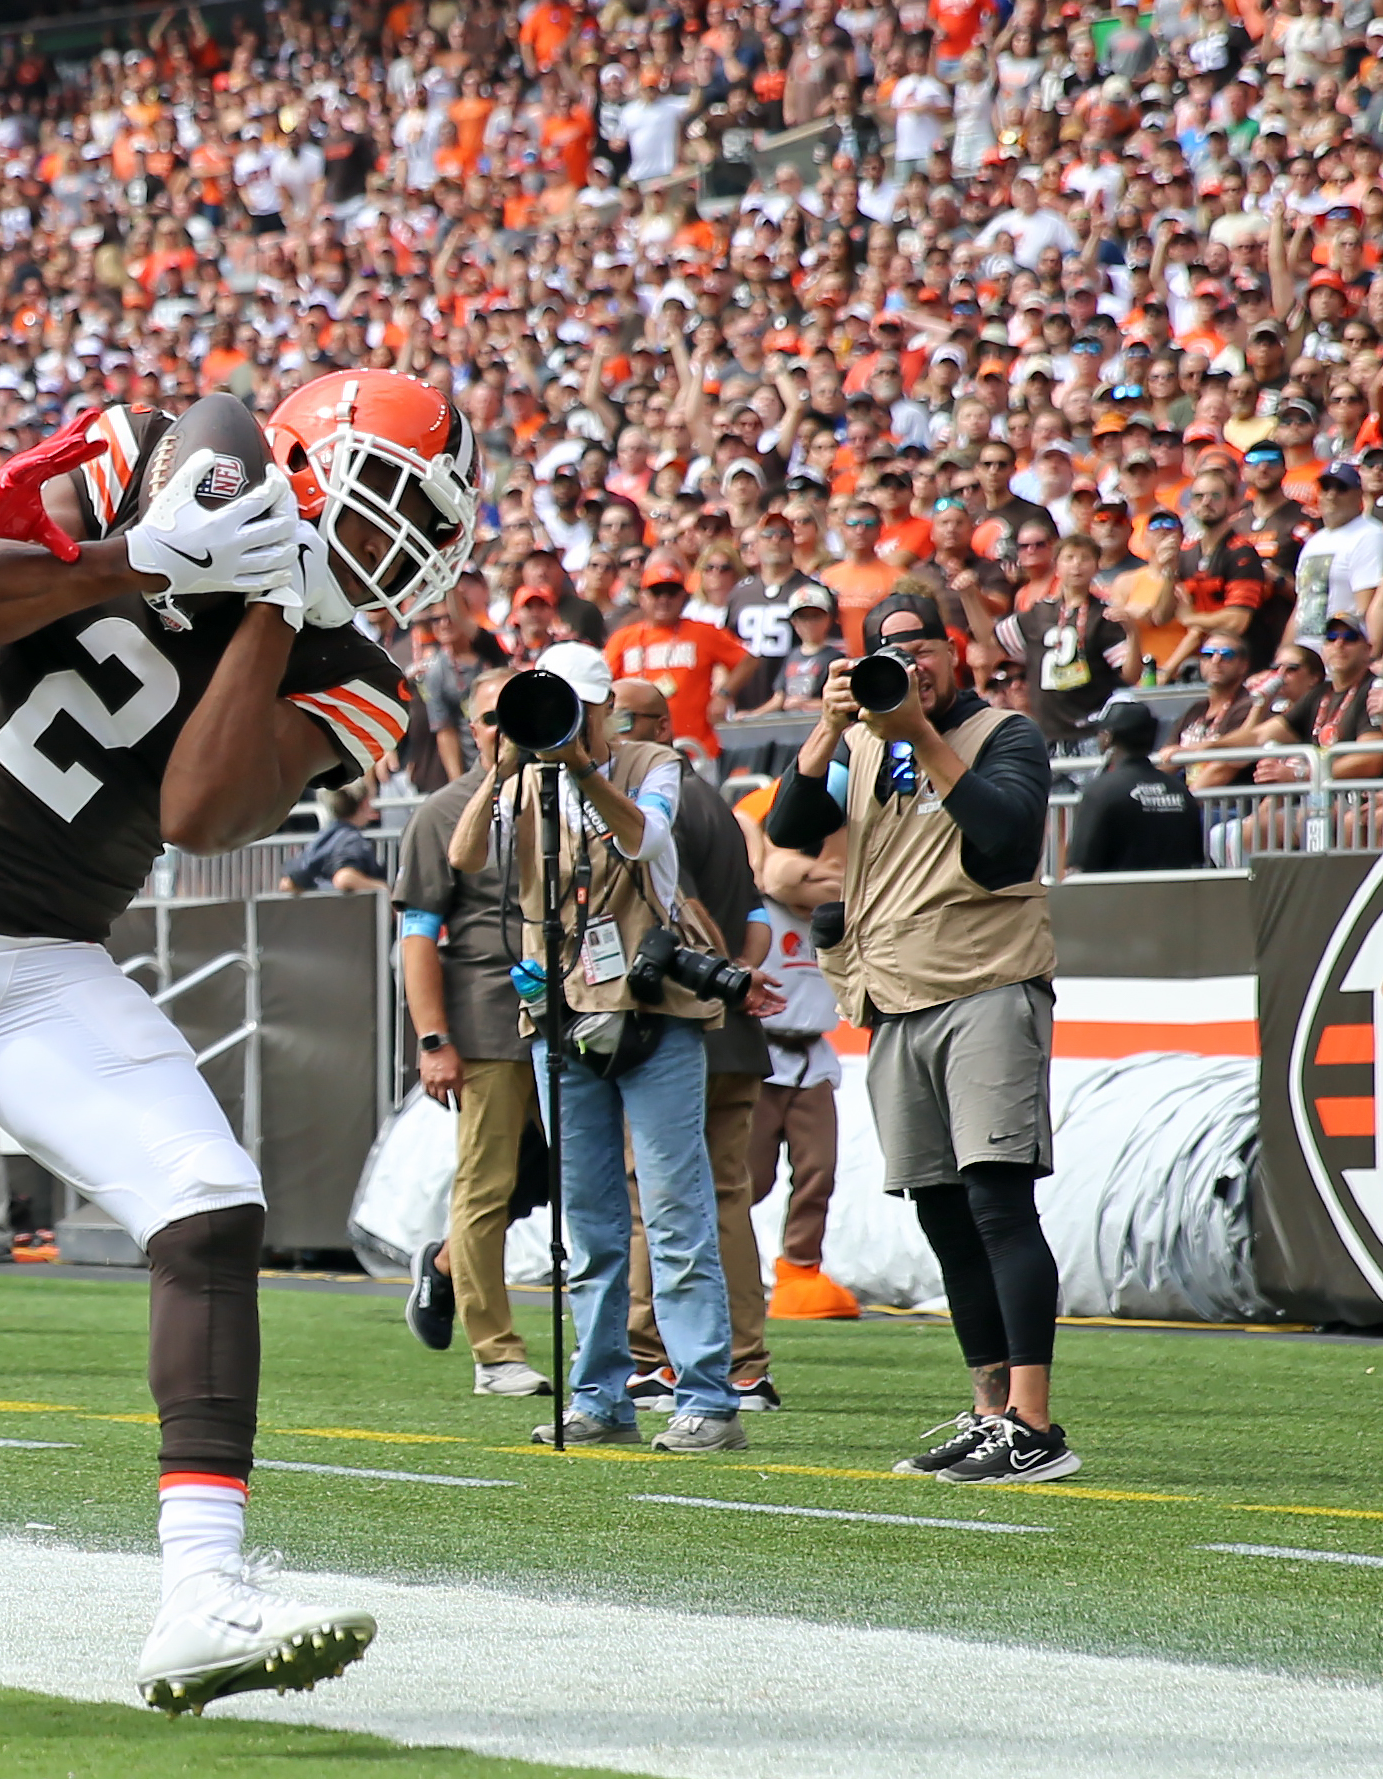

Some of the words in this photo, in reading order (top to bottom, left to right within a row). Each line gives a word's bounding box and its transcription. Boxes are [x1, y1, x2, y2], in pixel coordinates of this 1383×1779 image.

[213, 461, 242, 495] NFL
[738, 604, 794, 659] 95
[1040, 625, 1079, 691] 2
